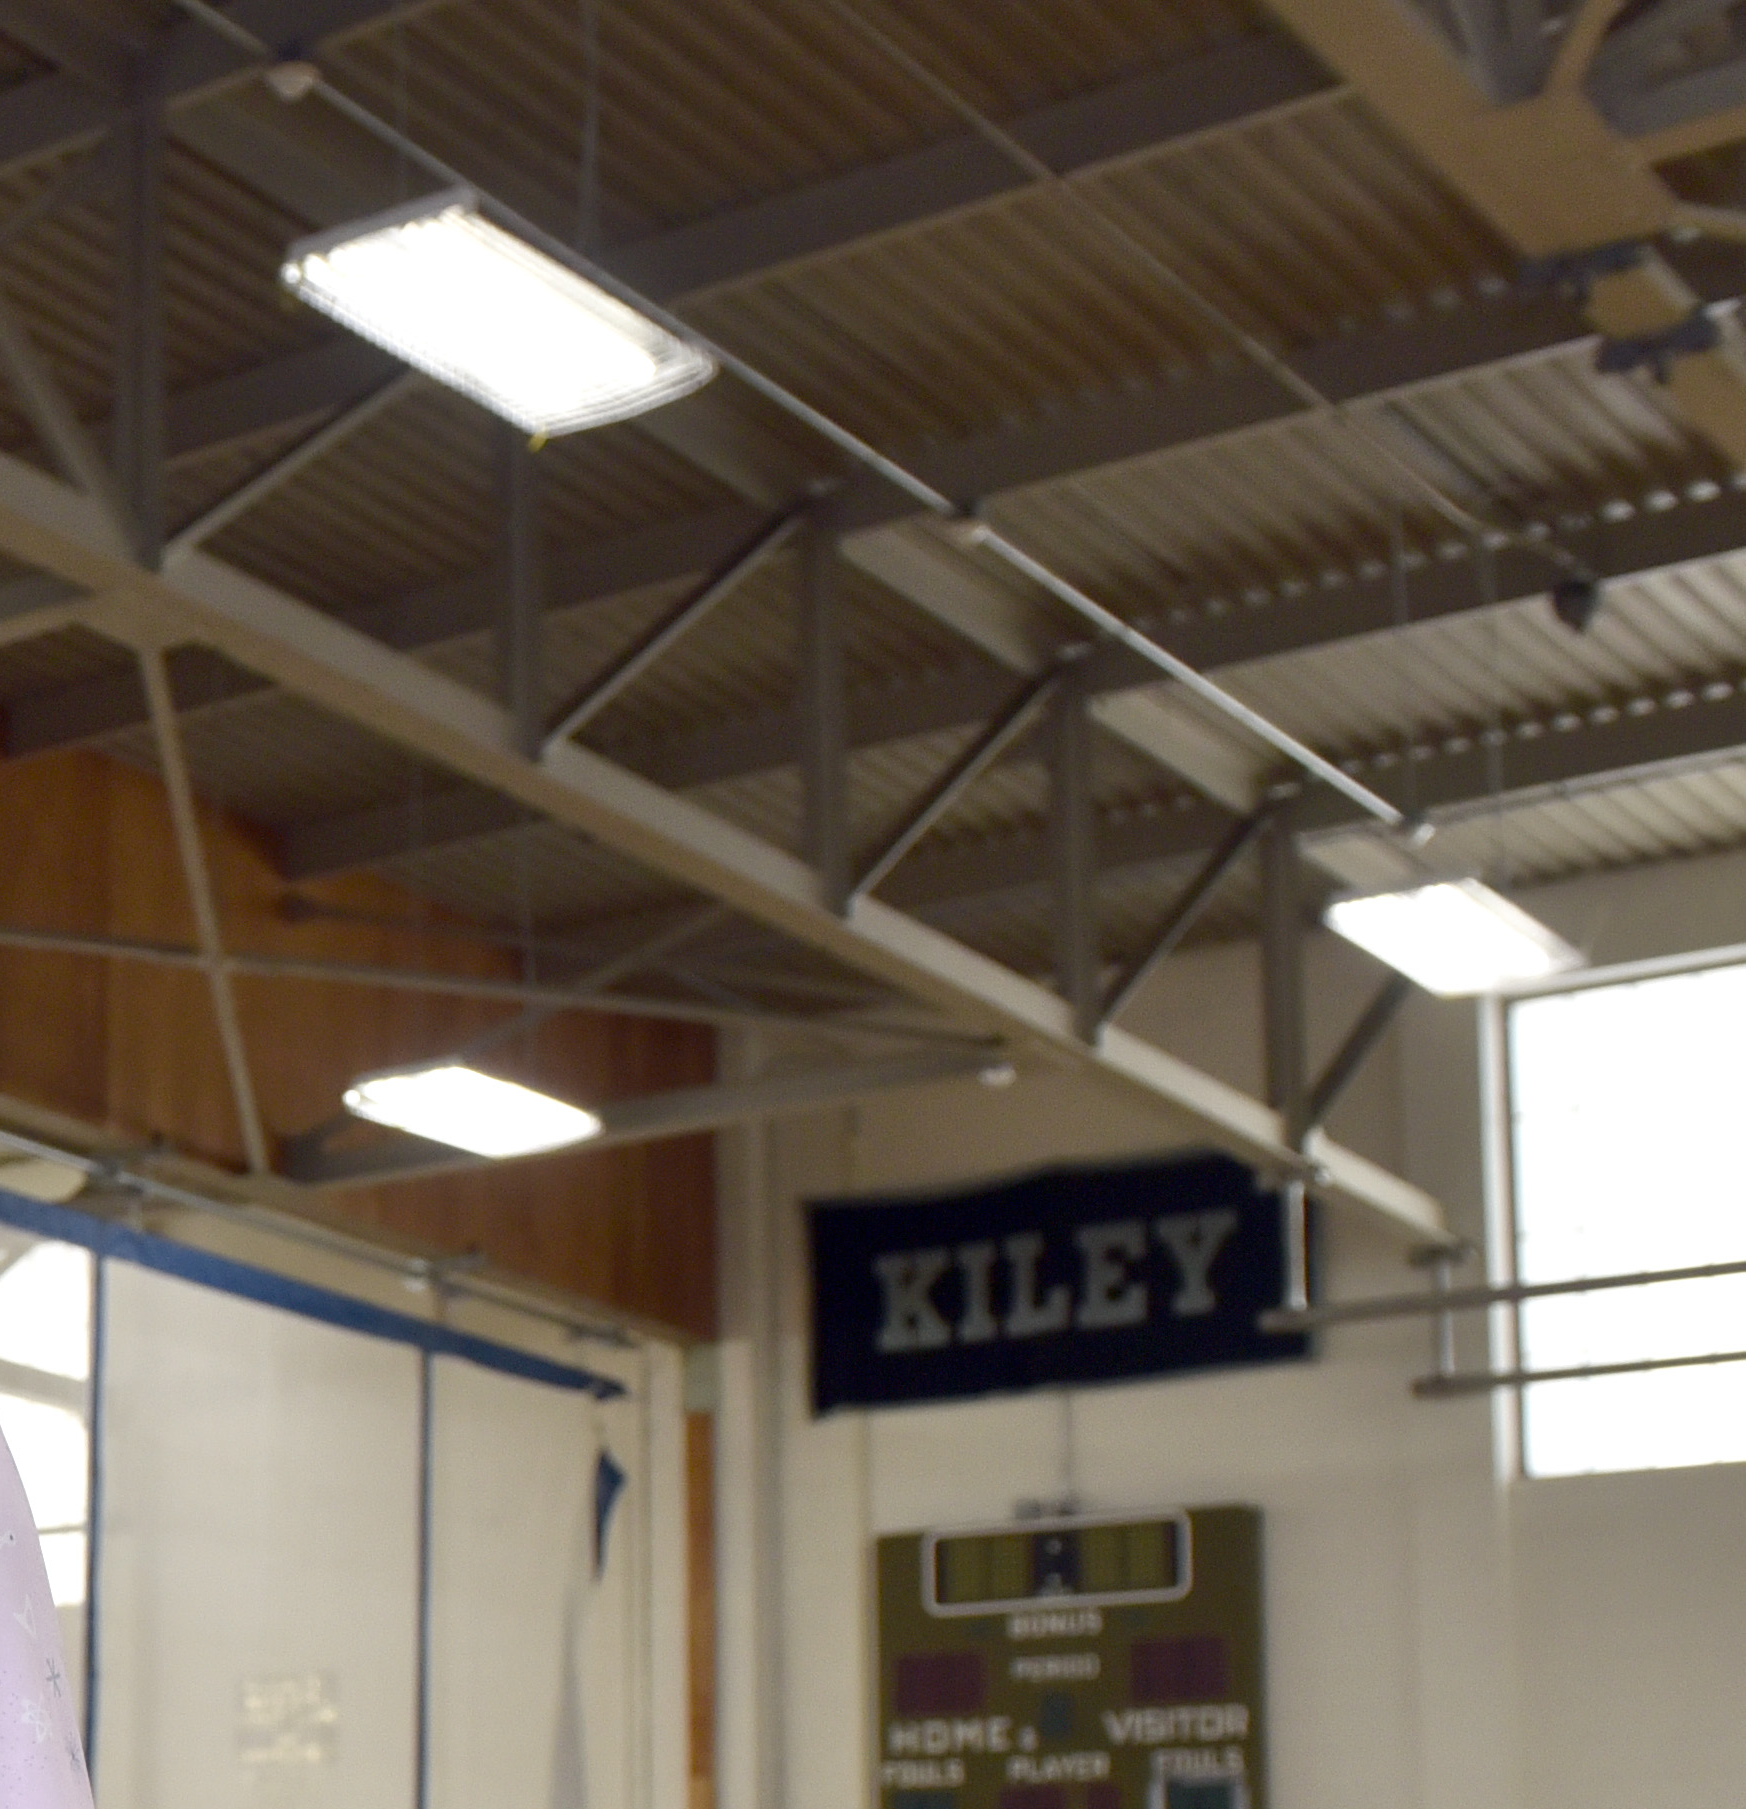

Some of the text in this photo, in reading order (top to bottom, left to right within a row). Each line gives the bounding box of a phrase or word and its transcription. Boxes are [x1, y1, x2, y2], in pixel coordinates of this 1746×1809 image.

[873, 1207, 1238, 1353] KILEY
[887, 1715, 1011, 1755] HOME
[1102, 1704, 1250, 1744] VISITOR
[1008, 1751, 1111, 1782] PLAYER
